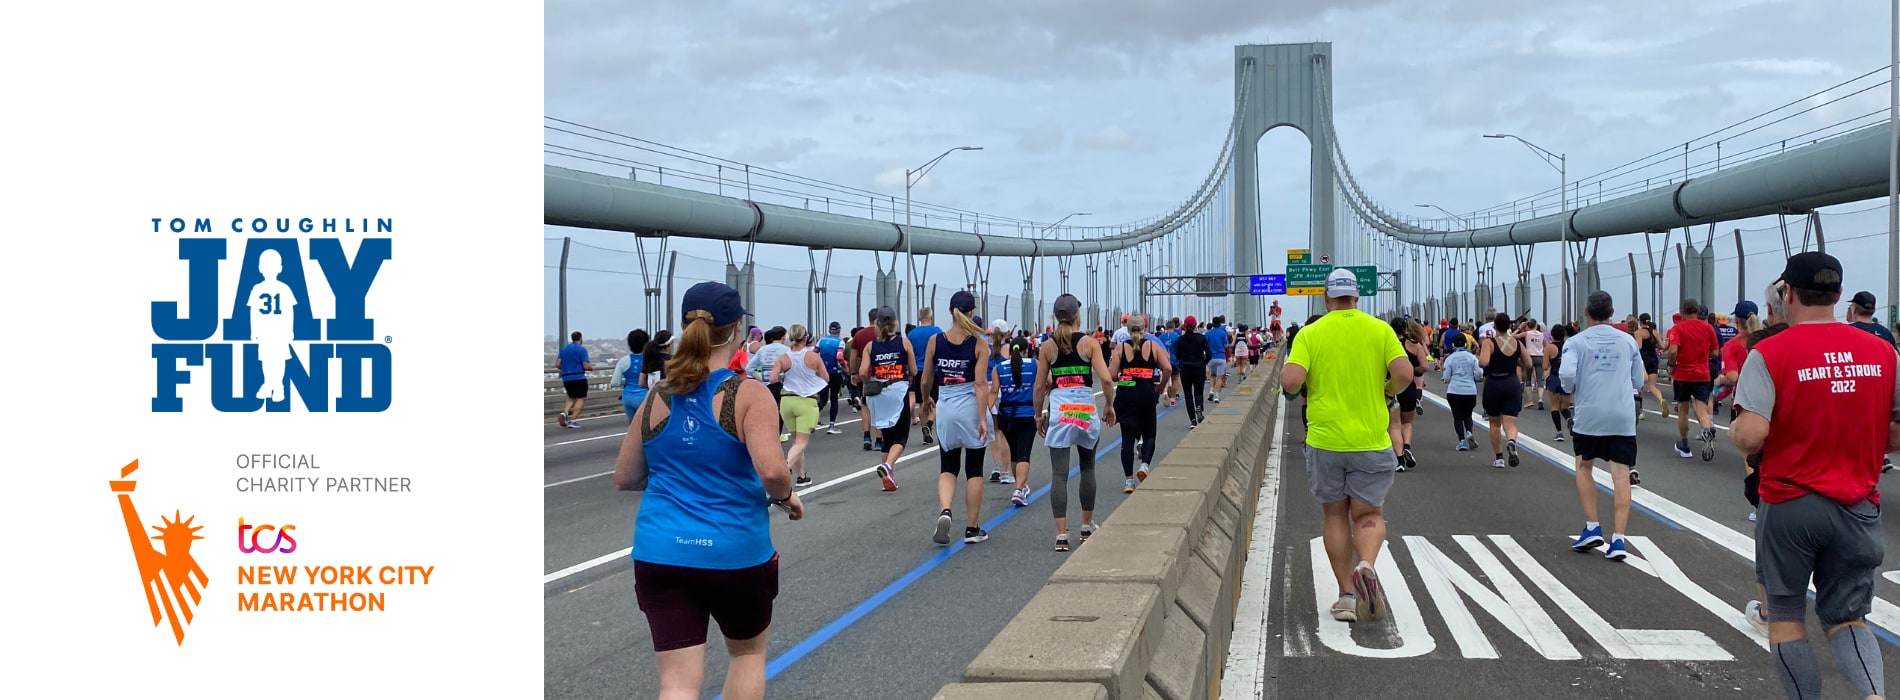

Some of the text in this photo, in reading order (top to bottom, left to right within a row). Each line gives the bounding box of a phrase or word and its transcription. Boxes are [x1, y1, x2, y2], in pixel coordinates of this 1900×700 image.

[875, 353, 894, 361] JDRF
[1824, 352, 1853, 364] TEAM
[937, 358, 961, 368] JDRF
[1797, 364, 1882, 382] HEART & STROKE
[1831, 380, 1856, 393] 2022
[675, 536, 713, 547] TeamHSS
